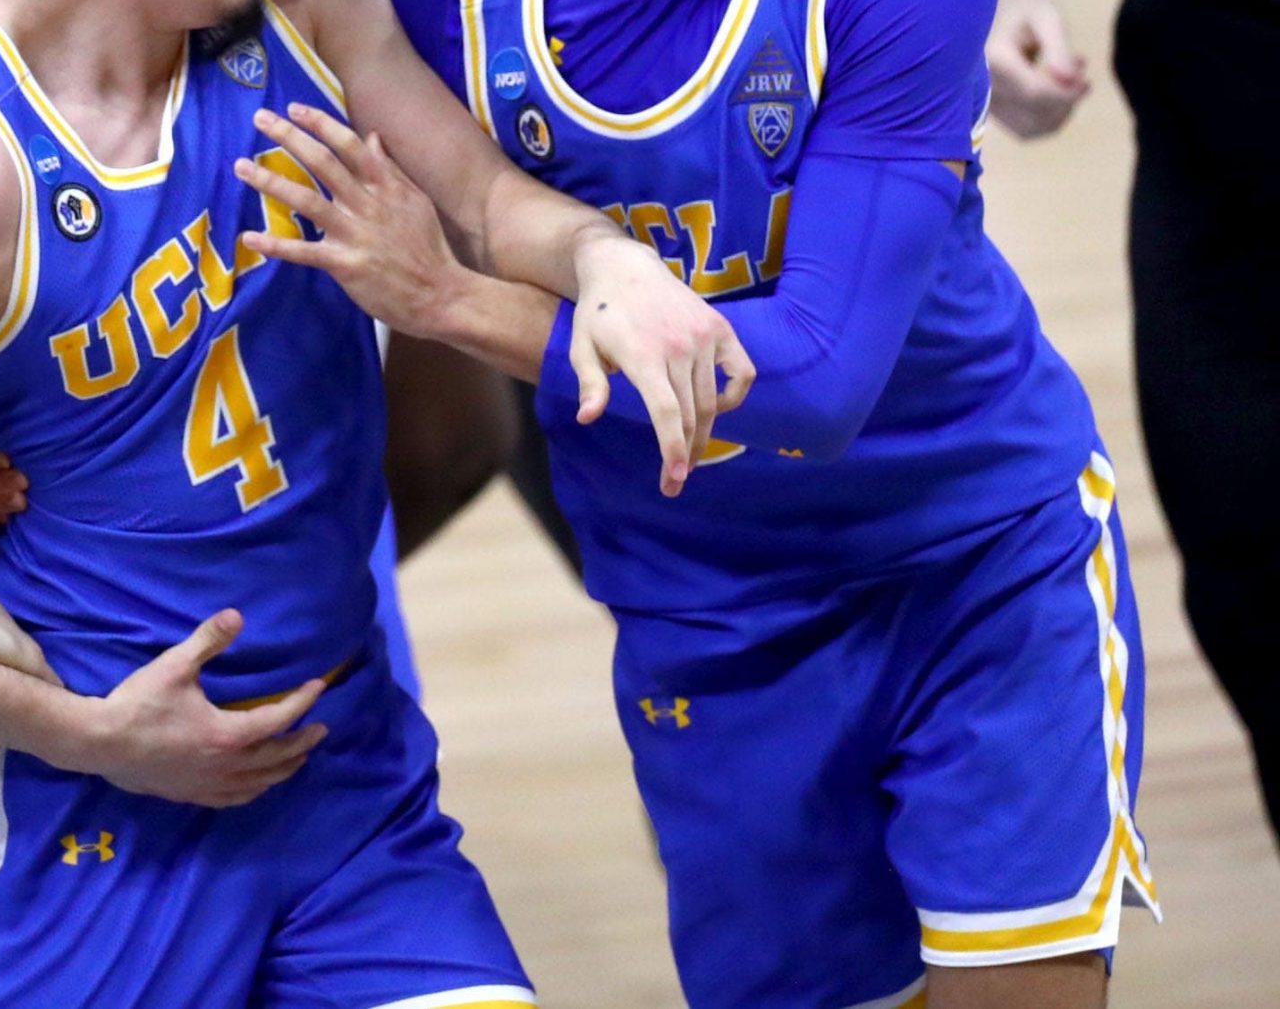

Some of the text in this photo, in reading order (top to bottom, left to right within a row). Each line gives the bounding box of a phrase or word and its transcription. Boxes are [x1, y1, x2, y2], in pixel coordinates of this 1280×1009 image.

[744, 74, 792, 93] JRW
[760, 124, 781, 145] 12
[182, 324, 290, 513] 4
